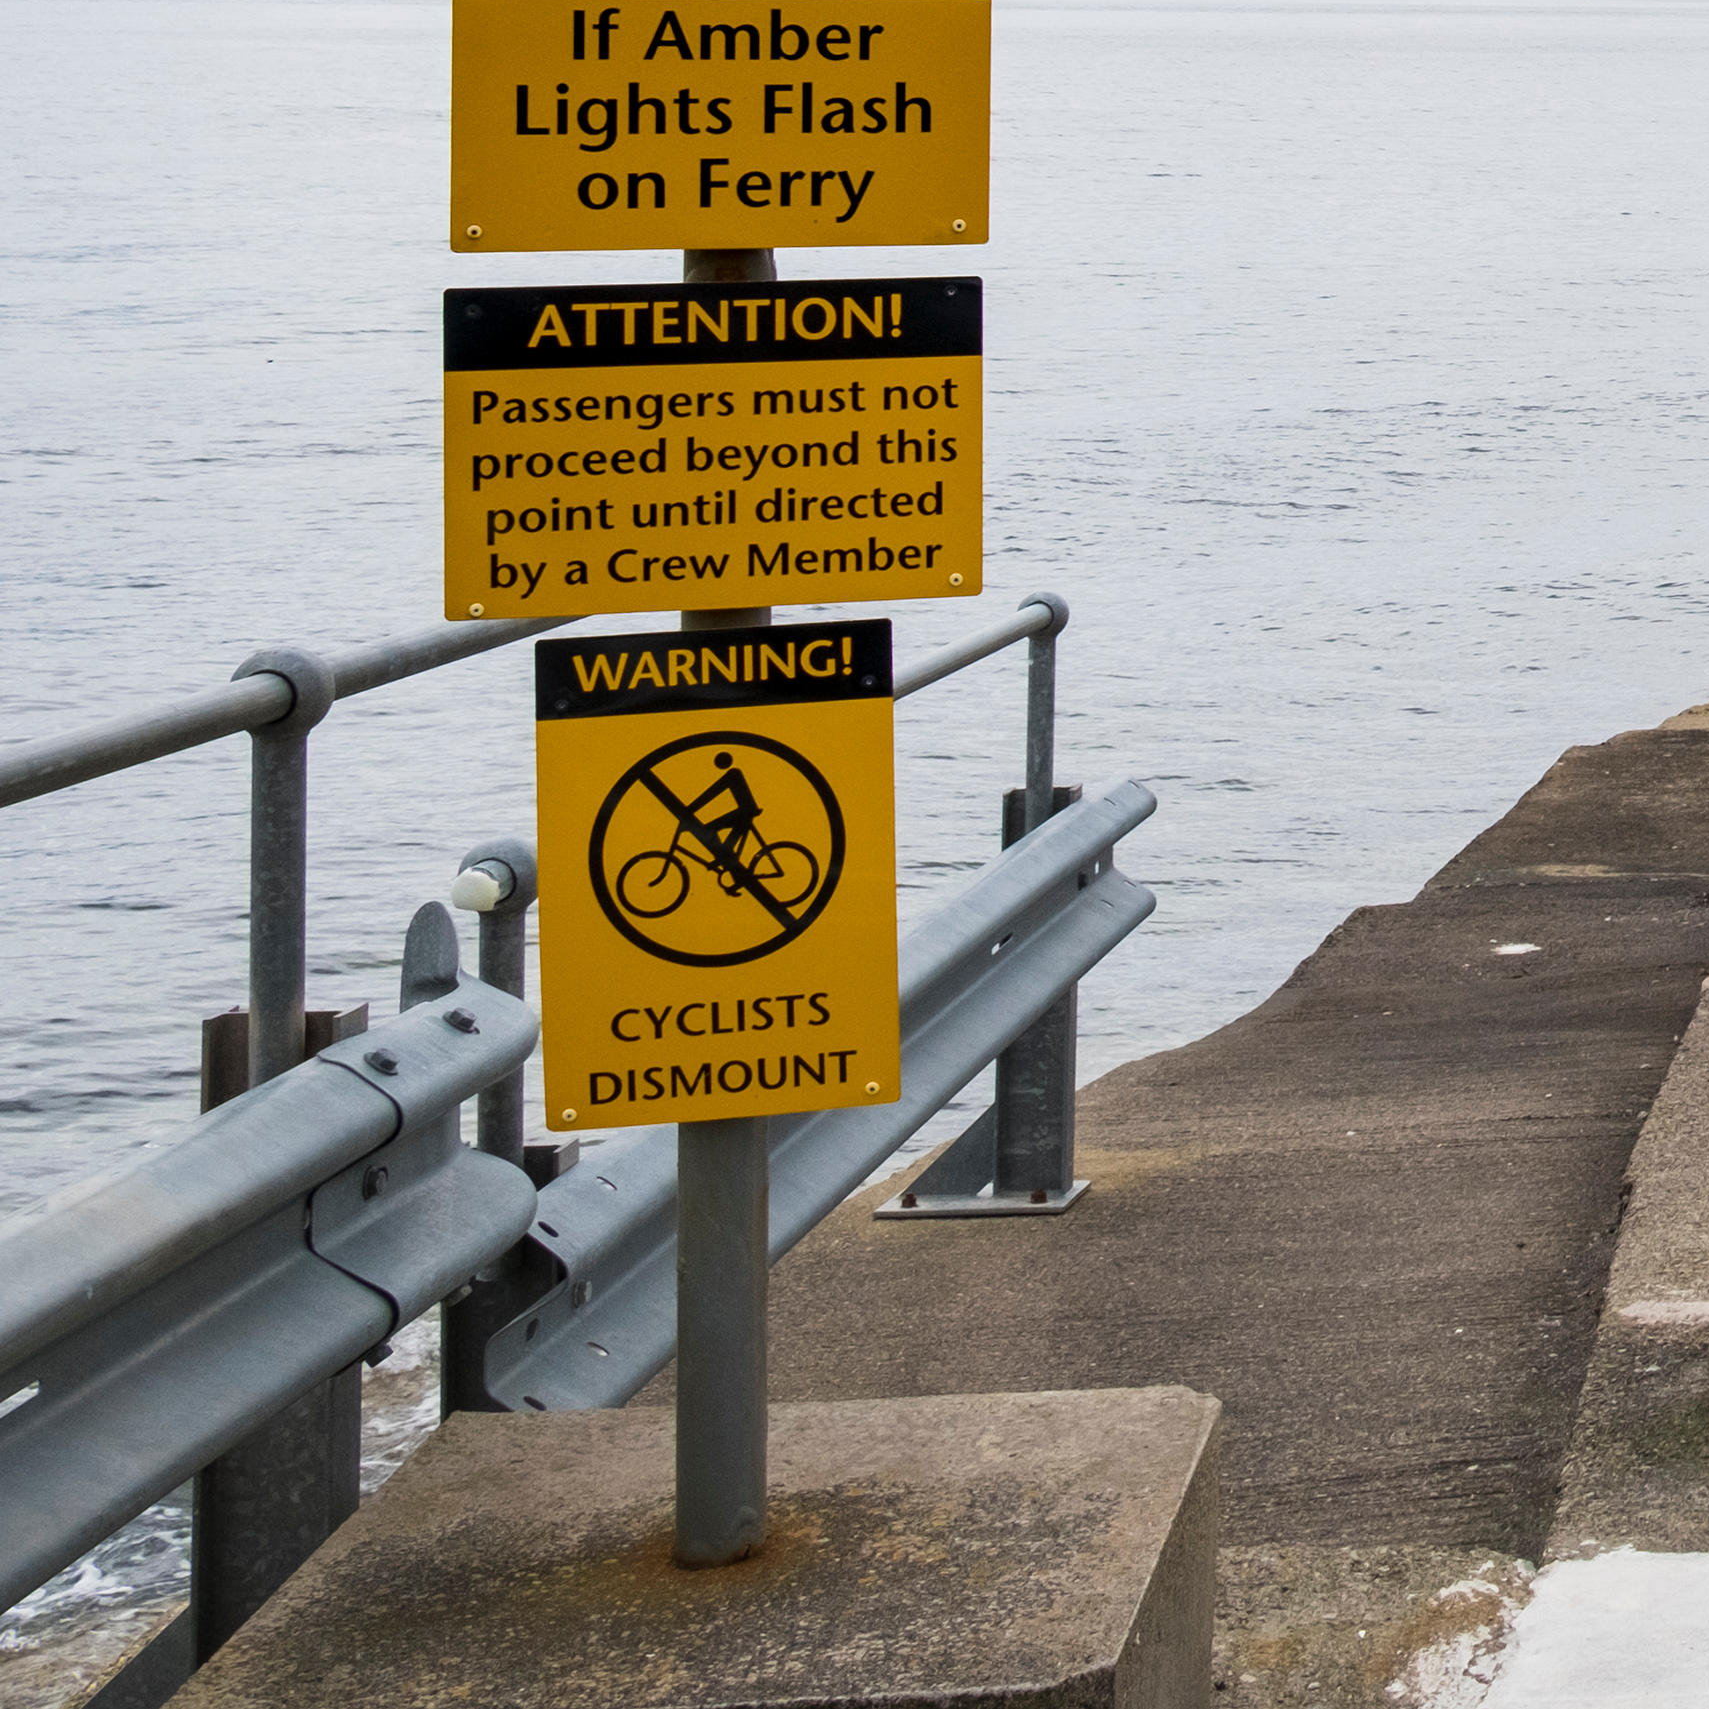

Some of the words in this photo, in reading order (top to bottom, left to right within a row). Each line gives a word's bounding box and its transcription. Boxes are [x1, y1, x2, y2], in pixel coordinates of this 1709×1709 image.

[573, 8, 620, 60] If
[644, 9, 884, 61] Amber
[517, 83, 732, 152] Lights
[764, 82, 931, 133] Flash
[578, 173, 665, 210] on
[700, 158, 874, 223] Ferry
[528, 294, 901, 347] ATTENTION!
[473, 391, 734, 430] Passengers
[754, 382, 865, 414] must
[884, 379, 958, 410] not
[473, 438, 666, 491] proceed
[687, 431, 858, 481] beyond
[877, 429, 957, 464] this
[487, 497, 614, 545] point
[633, 490, 735, 528] until
[756, 481, 942, 523] directed
[491, 554, 546, 599] by
[565, 561, 588, 585] a
[608, 549, 729, 583] Crew
[749, 537, 942, 576] Member
[573, 637, 852, 691] WARNING!
[611, 993, 830, 1042] CYCLISTS
[590, 1050, 857, 1105] DISMOUNT
